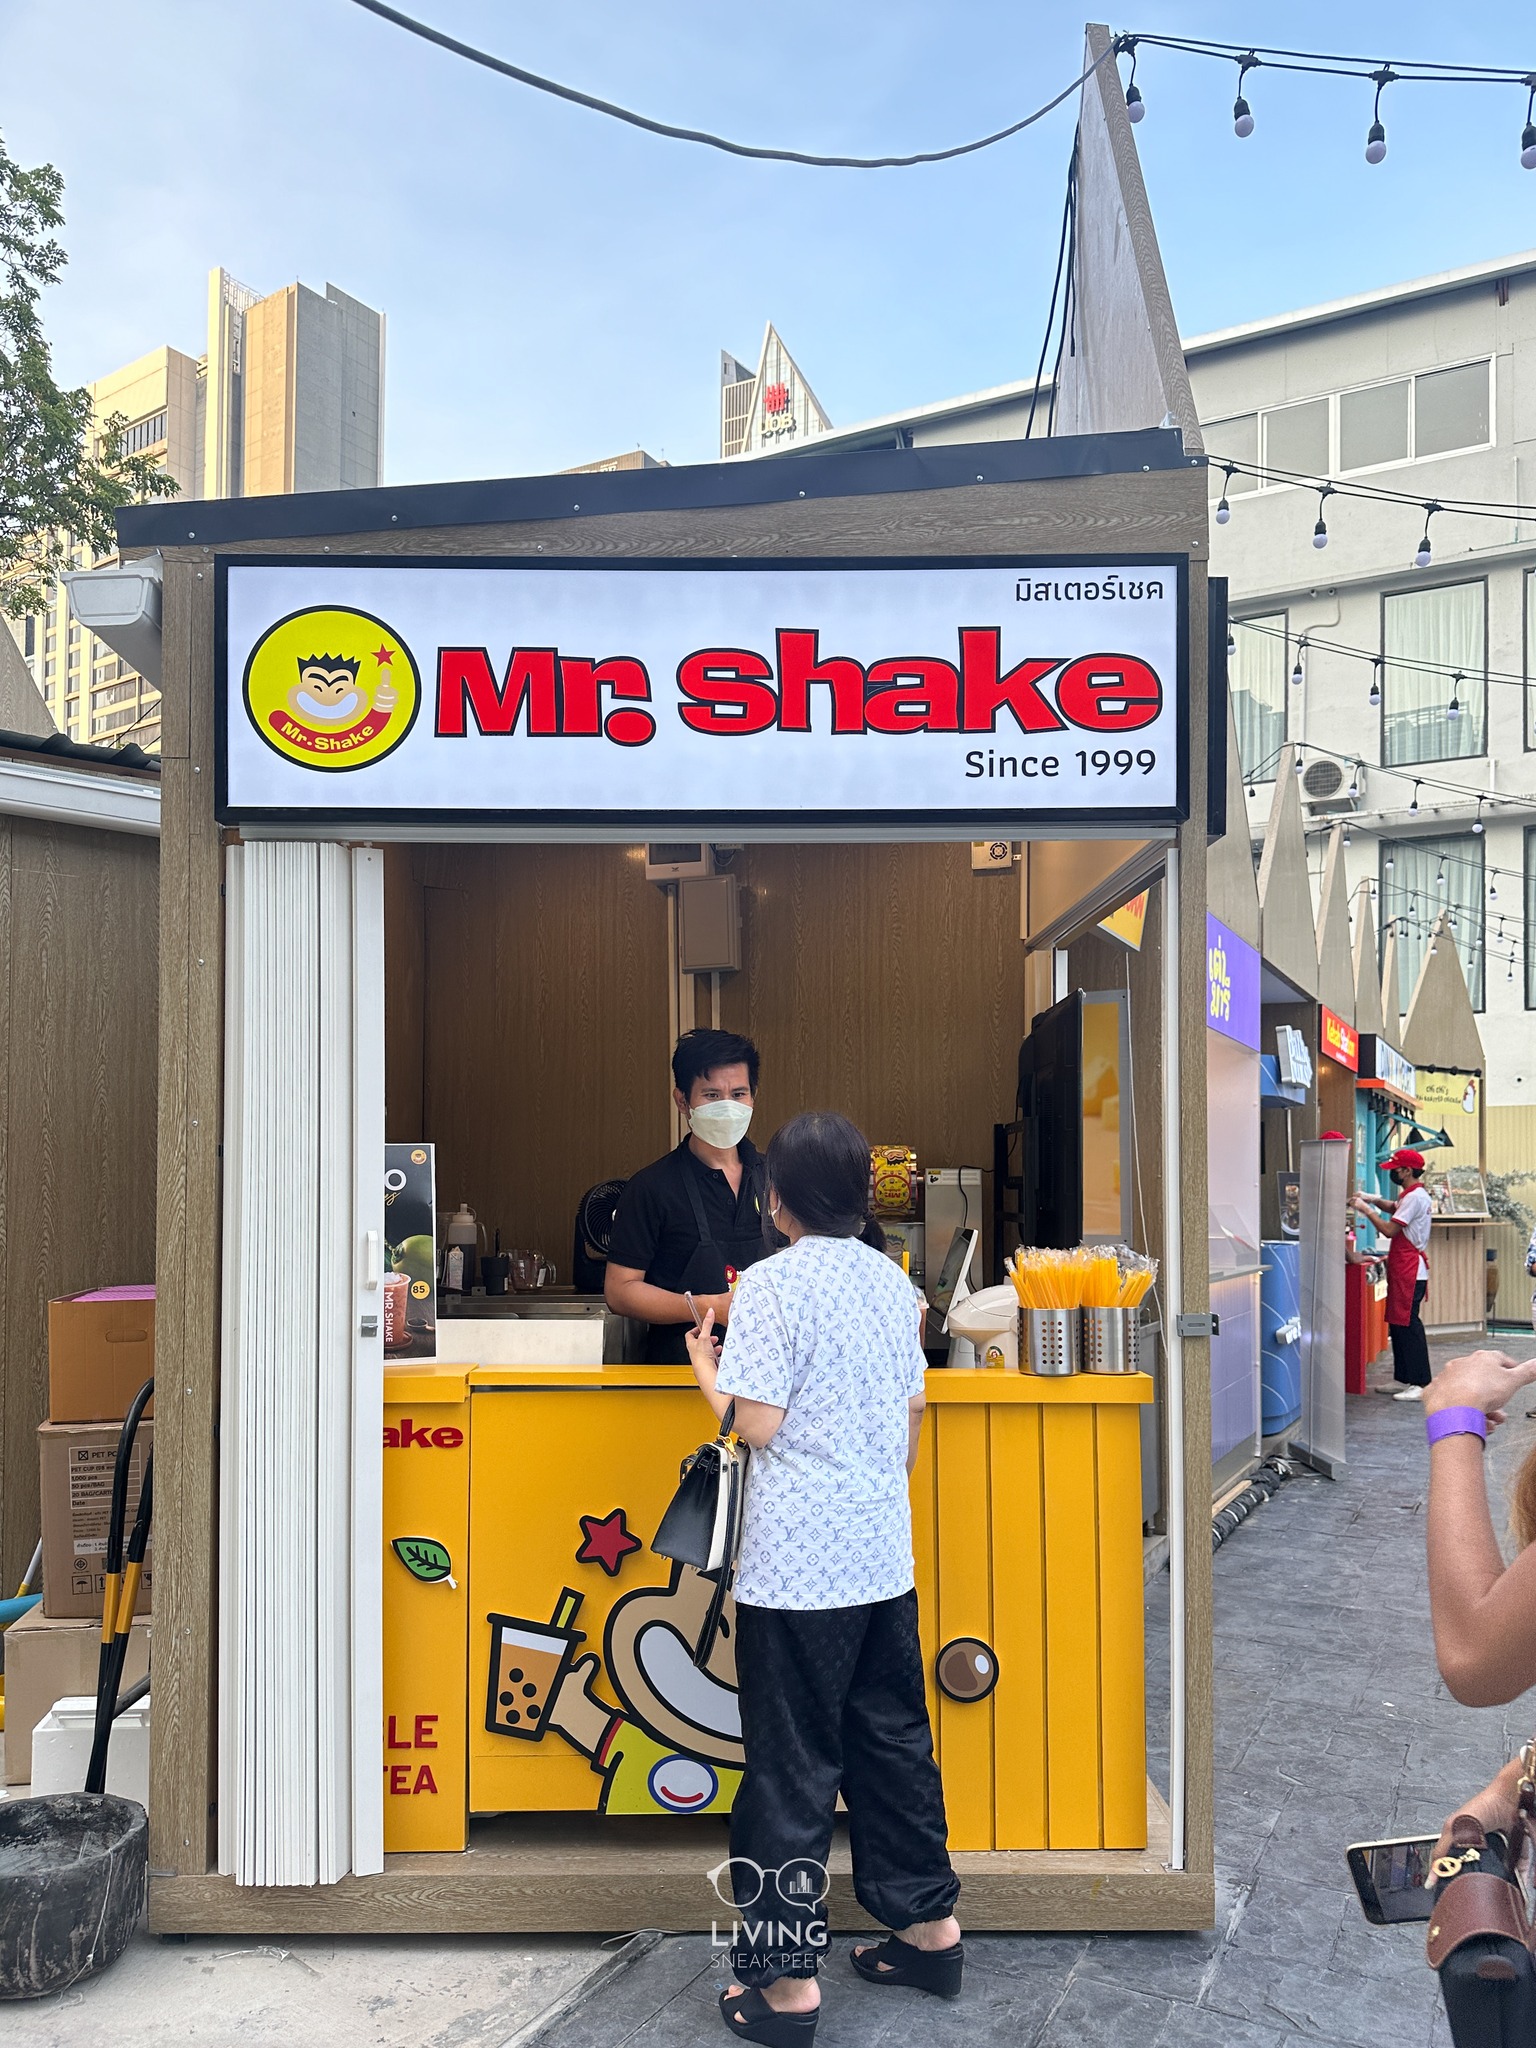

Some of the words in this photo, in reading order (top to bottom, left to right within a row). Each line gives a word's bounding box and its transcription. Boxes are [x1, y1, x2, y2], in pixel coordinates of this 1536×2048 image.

[1016, 575, 1164, 601] มิสเตอร์เชค
[434, 647, 656, 747] Mr.
[676, 626, 1163, 735] shake
[965, 749, 1060, 777] Since
[1075, 749, 1156, 776] 1999
[412, 1285, 426, 1294] 85
[383, 1418, 464, 1449] ake
[91, 1451, 106, 1459] PET
[387, 1714, 439, 1749] LE
